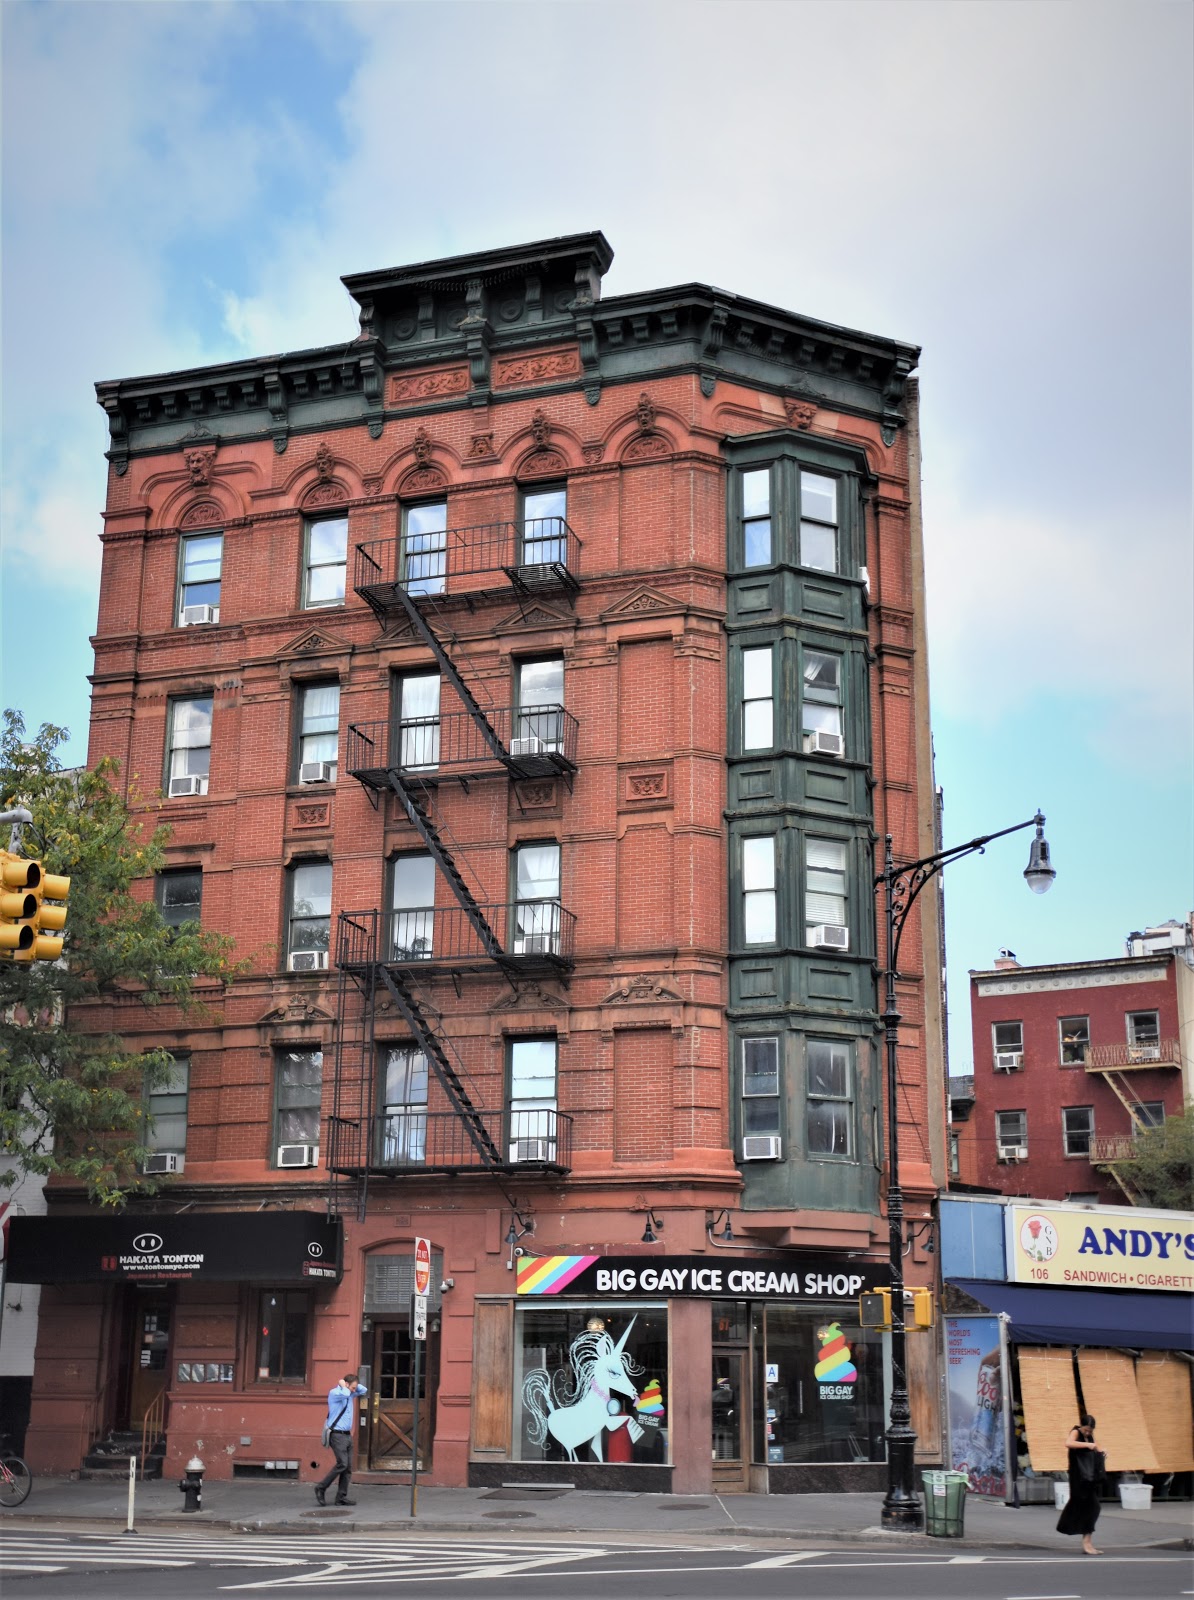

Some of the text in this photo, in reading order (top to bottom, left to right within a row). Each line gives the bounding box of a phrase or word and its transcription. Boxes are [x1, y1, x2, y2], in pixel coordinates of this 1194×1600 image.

[1078, 1226, 1194, 1261] ANDY'S
[162, 1254, 204, 1263] TONTON
[596, 1268, 862, 1296] BIG GAY ICE CREAM SHOP
[1030, 1268, 1049, 1280] 106
[1063, 1269, 1127, 1284] SANDWICH
[768, 1366, 776, 1378] A
[820, 1386, 853, 1395] BIG GAY
